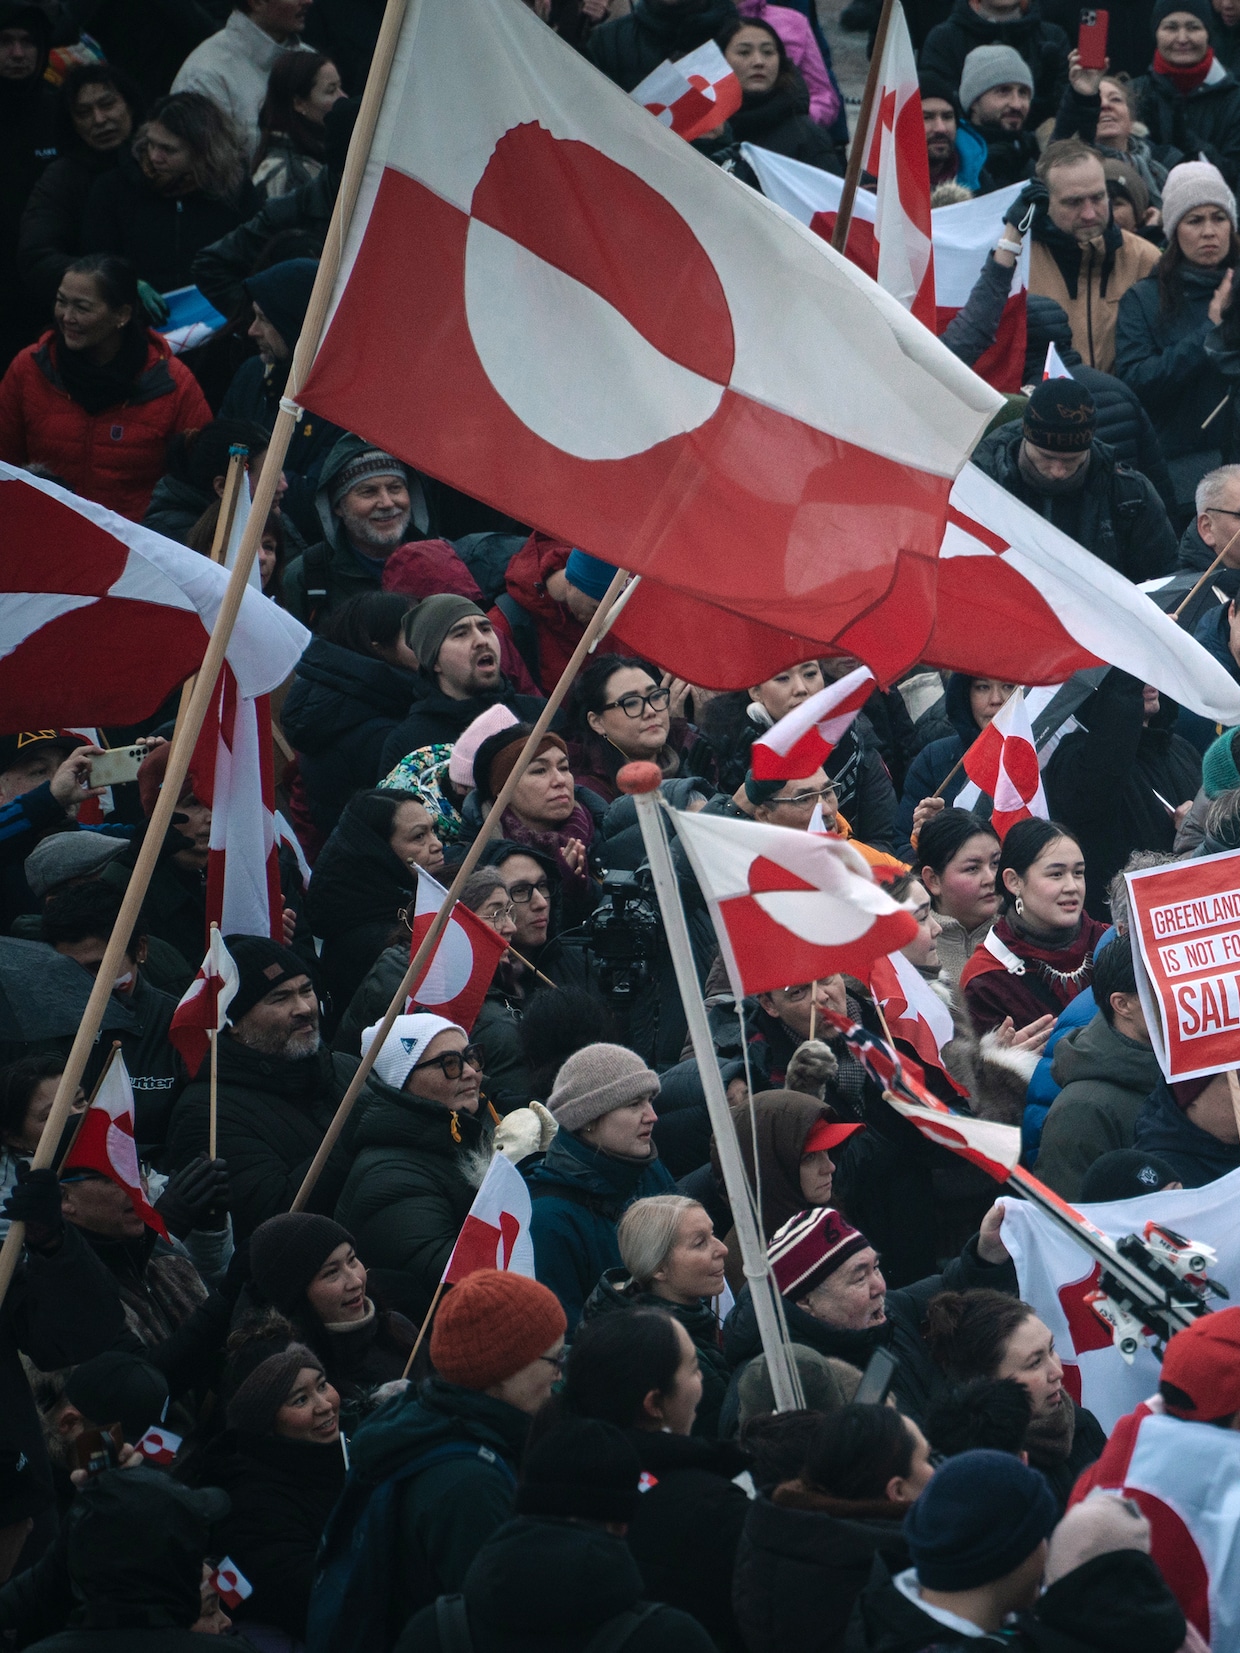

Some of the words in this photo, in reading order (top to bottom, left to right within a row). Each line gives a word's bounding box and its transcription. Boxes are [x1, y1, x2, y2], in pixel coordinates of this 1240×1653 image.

[1162, 949, 1181, 973] IS
[1184, 940, 1216, 968] NOT
[129, 1076, 175, 1090] utter
